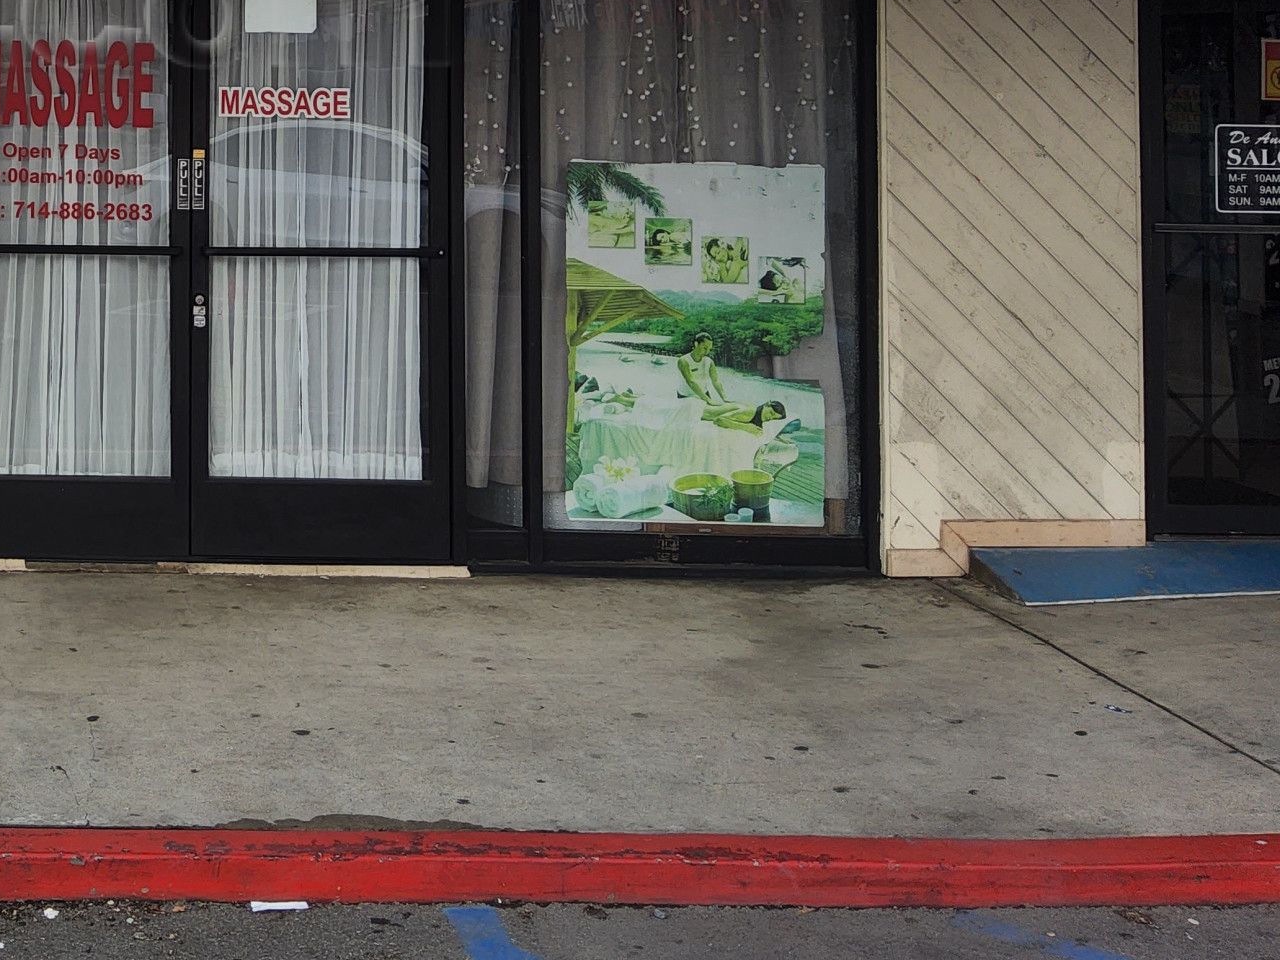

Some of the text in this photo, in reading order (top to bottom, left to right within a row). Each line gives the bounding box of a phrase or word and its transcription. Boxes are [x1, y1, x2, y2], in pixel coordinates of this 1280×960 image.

[220, 88, 350, 117] MASSAGE
[1229, 131, 1251, 144] De
[2, 142, 121, 163] Open 7 Days
[1226, 148, 1280, 166] SAL
[180, 161, 188, 197] PULL
[194, 161, 203, 197] PULL
[1228, 174, 1247, 182] M-F
[1228, 185, 1249, 194] SAT
[13, 201, 153, 221] 714-886-2683
